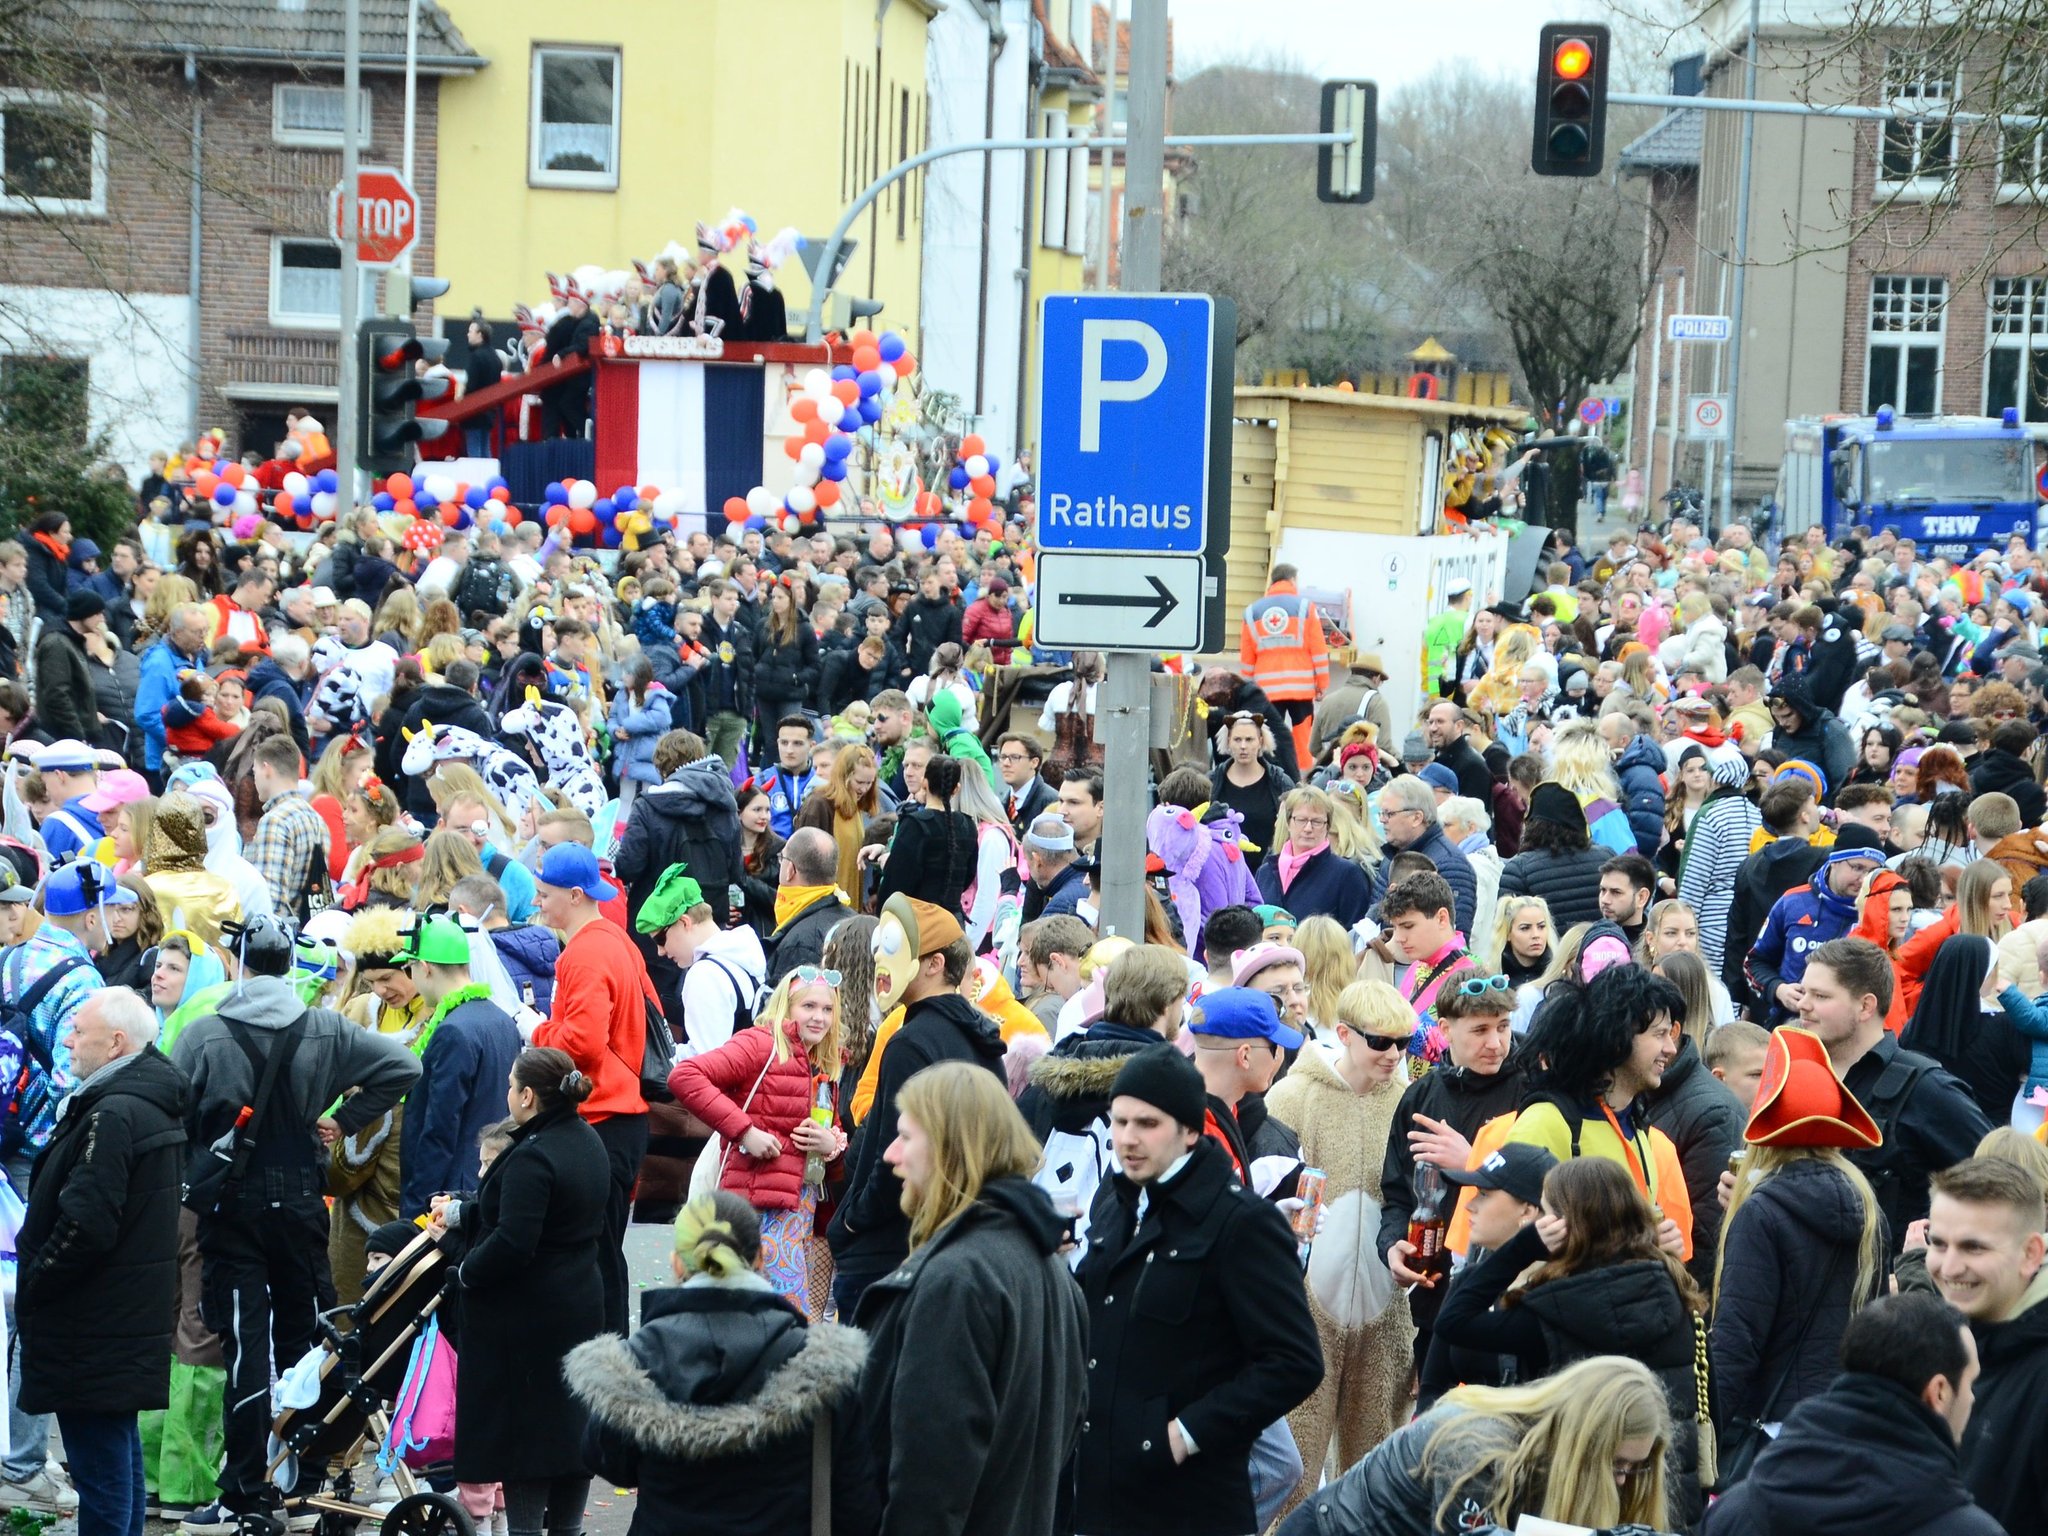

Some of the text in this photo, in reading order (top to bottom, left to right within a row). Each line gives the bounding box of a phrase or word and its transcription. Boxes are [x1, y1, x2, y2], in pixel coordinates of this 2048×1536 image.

[357, 198, 411, 239] TOP
[1674, 321, 1725, 338] POLIZEI
[1080, 319, 1168, 453] P
[1702, 408, 1718, 419] 30
[1050, 493, 1191, 530] Rathaus
[1923, 516, 1980, 537] THW
[1934, 545, 1968, 554] IVECO
[1390, 557, 1397, 572] 6
